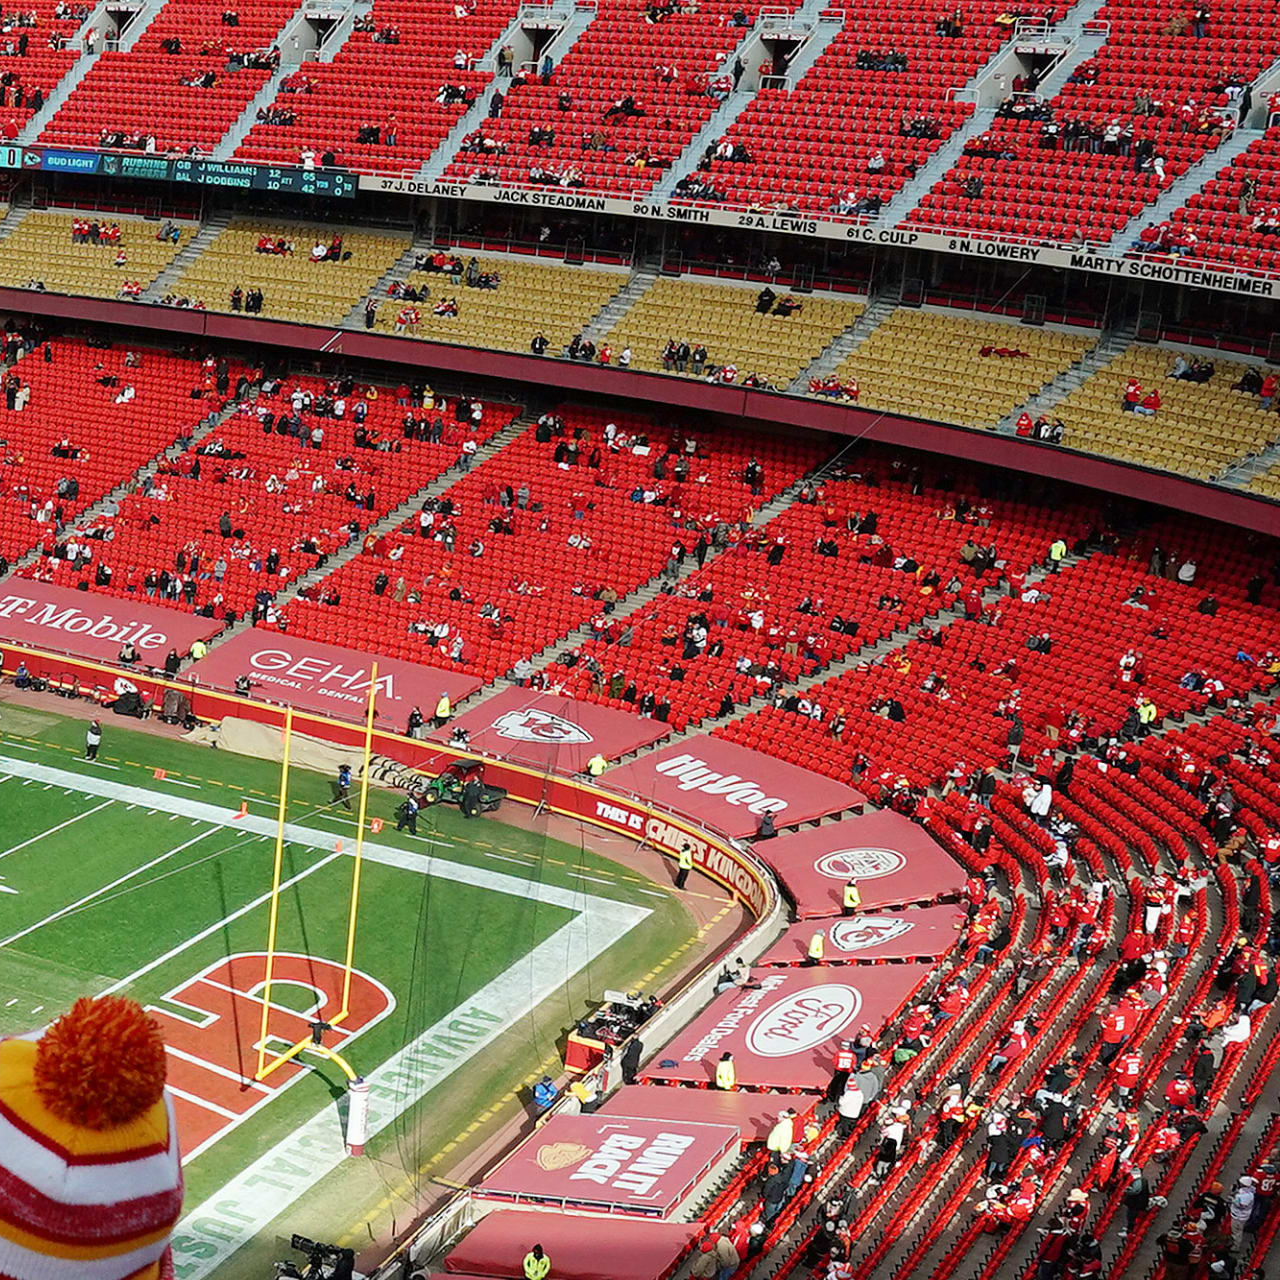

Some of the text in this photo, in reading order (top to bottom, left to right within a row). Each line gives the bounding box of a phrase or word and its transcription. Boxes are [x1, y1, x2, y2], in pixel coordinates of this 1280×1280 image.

[48, 156, 94, 169] BUD LIGHT
[269, 169, 281, 179] 12
[206, 176, 251, 188] DOBBINS
[267, 181, 280, 191] 10
[301, 184, 316, 194] 42
[381, 180, 467, 197] 37 J. DELANEY
[494, 190, 606, 210] JACK STEADMAN
[633, 204, 710, 222] 90 N. SMITH
[738, 216, 817, 234] 29 A. LEWIS
[846, 228, 919, 245] 61 C. CULP
[949, 239, 1040, 261] 8 N. LOWERY
[1071, 254, 1273, 296] MARTY SCHOTTENHEIMER
[24, 602, 169, 652] Mobile
[250, 649, 395, 701] GEHA
[248, 671, 365, 707] MEDICAL DENTAL
[655, 754, 788, 816] HyVee
[596, 801, 628, 824] THIS
[628, 813, 644, 830] IS
[763, 997, 845, 1042] Ford
[569, 1133, 648, 1185] BACK
[611, 1132, 696, 1196] RUN IT
